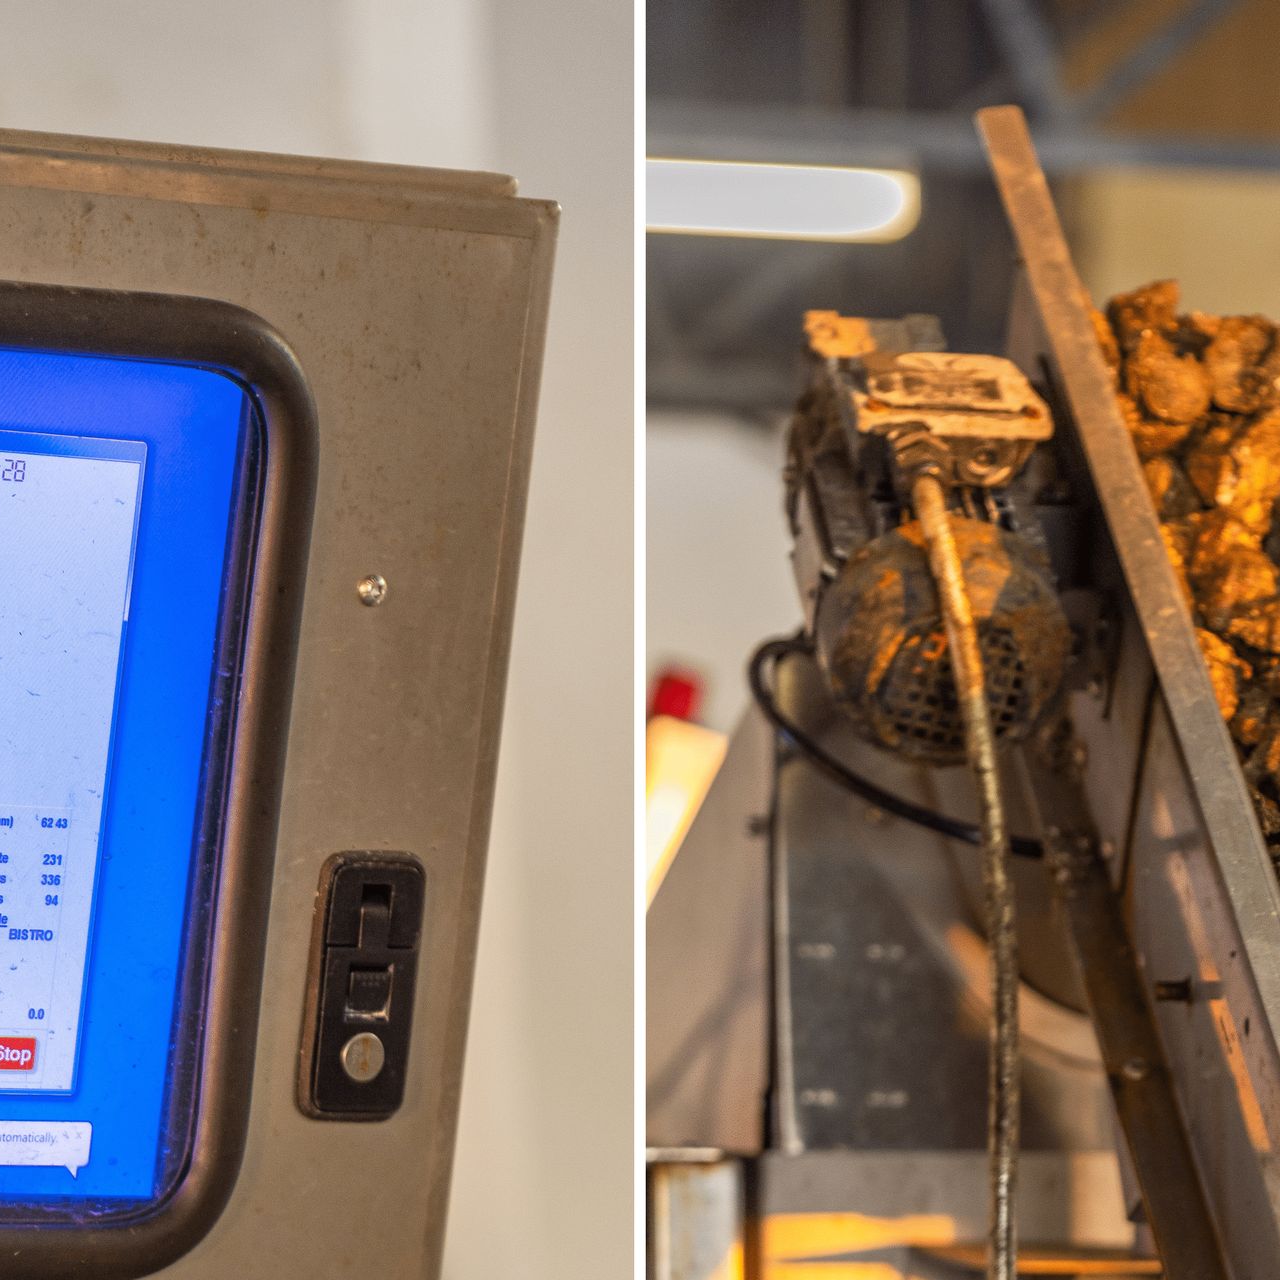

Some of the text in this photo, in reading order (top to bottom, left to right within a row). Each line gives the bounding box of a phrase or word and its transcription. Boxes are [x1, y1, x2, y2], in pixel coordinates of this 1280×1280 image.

[41, 818, 53, 828] 62
[55, 818, 68, 828] 43
[43, 854, 62, 865] 231
[41, 875, 61, 885] 336
[45, 895, 59, 906] 94
[28, 1008, 45, 1020] 0.0
